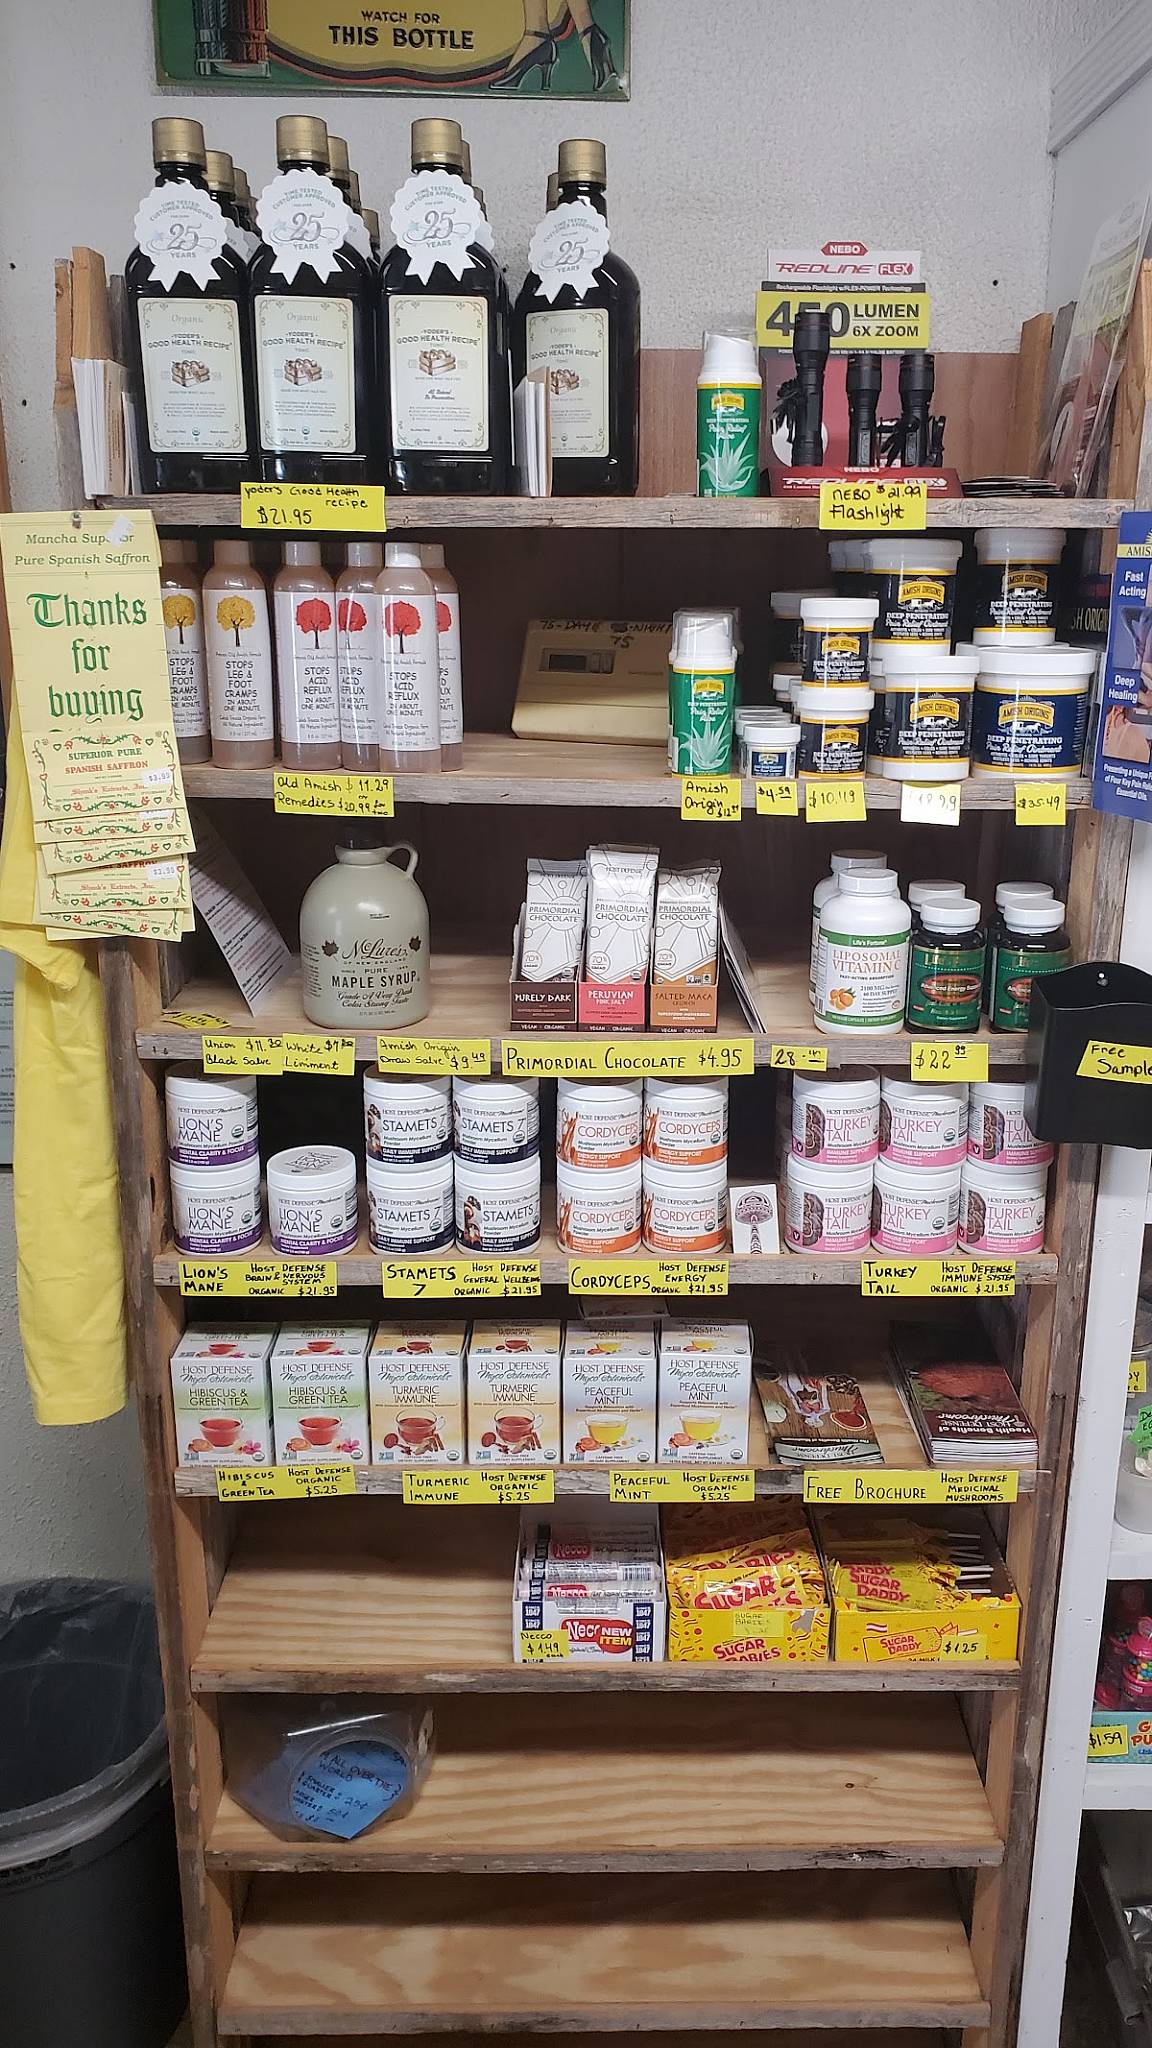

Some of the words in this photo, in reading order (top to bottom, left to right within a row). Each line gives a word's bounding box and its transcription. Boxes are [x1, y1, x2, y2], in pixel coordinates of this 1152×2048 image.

[361, 10, 406, 23] WATCH
[413, 13, 440, 24] FOR
[329, 25, 379, 47] THIS
[392, 28, 475, 50] BOTTLE
[293, 212, 325, 241] 25
[829, 245, 860, 253] NEBO
[776, 263, 876, 273] REDLINE
[880, 264, 910, 274] FLEX
[854, 305, 919, 317] LUMEN
[853, 326, 871, 336] 6X
[875, 326, 918, 336] ZOOM
[147, 341, 169, 349] GOOD
[290, 487, 322, 495] Good
[327, 488, 359, 496] Health
[832, 490, 870, 500] NEBO
[326, 499, 368, 508] recipe
[257, 506, 312, 524] $21.95
[830, 504, 904, 525] Flashlight
[26, 534, 76, 544] Mancha
[15, 556, 44, 565] Pure
[49, 554, 100, 566] Spanish
[105, 554, 150, 565] Saffron
[1125, 571, 1143, 582] Fast
[1119, 586, 1146, 599] Acting
[26, 592, 147, 627] Thanks
[72, 639, 110, 673] for
[228, 680, 252, 688] FOOT
[309, 676, 328, 684] ACID
[1115, 675, 1135, 687] Deep
[224, 690, 257, 698] CRAMPS
[304, 686, 332, 694] REFLUX
[1108, 688, 1138, 703] Healing
[49, 684, 144, 723] buying
[1003, 708, 1022, 718] AMISH
[1024, 706, 1050, 718] ORIGINS
[69, 751, 113, 760] SUPERIOR
[118, 748, 142, 756] PURE
[65, 765, 103, 774] SPANISH
[107, 761, 148, 770] SAFFRON
[278, 777, 298, 788] Old
[305, 778, 341, 791] Amish
[686, 781, 728, 793] Amish
[275, 792, 334, 808] Remedies
[685, 797, 723, 815] Origin
[832, 960, 891, 973] VITAMIN
[332, 976, 374, 988] MAPLE
[515, 994, 545, 1002] PURELY
[547, 993, 571, 1002] DARK
[588, 990, 634, 999] PERUVIAN
[205, 1039, 236, 1048] Union
[287, 1044, 323, 1054] White
[380, 1039, 417, 1050] Amish
[424, 1042, 460, 1059] Origin
[1092, 1045, 1126, 1058] Free
[206, 1054, 237, 1064] Black
[243, 1057, 271, 1065] Salve
[416, 1056, 444, 1065] Salve
[507, 1047, 596, 1070] PRIMORDIAL
[605, 1047, 686, 1070] CHOCOLATE
[698, 1047, 742, 1067] $4.95
[178, 1118, 223, 1131] LION'S
[893, 1119, 942, 1131] TURKEY
[178, 1129, 220, 1142] MANE
[893, 1130, 916, 1142] TAIL
[183, 1264, 228, 1279] LION'S
[251, 1263, 275, 1272] HOST
[282, 1264, 326, 1272] DEFENSE
[387, 1264, 456, 1280] STAMETS
[472, 1263, 493, 1272] HOST
[501, 1263, 537, 1272] DEFENSE
[659, 1262, 681, 1272] HOST
[687, 1263, 726, 1273] DEFENSE
[864, 1262, 917, 1278] TURKEY
[942, 1262, 966, 1273] HOST
[972, 1262, 1012, 1274] DEFENSE
[464, 1275, 499, 1283] GENERAL
[571, 1267, 650, 1289] CORDYCEPS
[665, 1274, 706, 1282] ENERGY
[942, 1274, 982, 1282] IMMUNE
[184, 1281, 223, 1292] MANE
[298, 1286, 334, 1296] $21.95
[413, 1284, 426, 1296] 7
[454, 1287, 491, 1296] ORGANIC
[500, 1285, 537, 1297] $21.95
[689, 1283, 723, 1294] $21.95
[866, 1281, 899, 1294] TAIL
[931, 1285, 968, 1293] ORGANIC
[976, 1283, 1009, 1293] $21.95
[211, 1366, 252, 1374] DEFENSE
[190, 1389, 236, 1397] HIBISCUS
[219, 1471, 274, 1481] HIBISCUS
[288, 1468, 309, 1476] HOST
[481, 1472, 505, 1482] HOST
[509, 1473, 546, 1481] DEFENSE
[683, 1473, 707, 1482] HOST
[710, 1473, 750, 1482] DEFENSE
[296, 1476, 341, 1484] ORGANIC
[405, 1474, 469, 1487] TURMERIC
[614, 1474, 670, 1486] PEACEFUL
[941, 1472, 964, 1484] HOST
[968, 1473, 1008, 1482] DEFENSE
[222, 1488, 254, 1497] GREEN
[258, 1487, 275, 1496] TEA
[306, 1486, 338, 1497] $5.25
[692, 1484, 737, 1492] ORGANIC
[807, 1477, 842, 1499] FREE
[854, 1478, 926, 1500] BROCHURE
[948, 1484, 1000, 1492] MEDICINAL
[410, 1490, 459, 1501] IMMUNE
[499, 1492, 530, 1503] $5.25
[614, 1488, 651, 1500] MINT
[700, 1492, 730, 1501] $5.25
[946, 1493, 1003, 1502] MUSHROOMS
[857, 1585, 910, 1602] DADDY
[526, 1606, 540, 1616] 1847
[602, 1628, 632, 1636] NEW
[600, 1637, 631, 1645] ITEM
[528, 1643, 558, 1654] $1.49
[714, 1639, 765, 1658] SUGAR
[945, 1641, 978, 1654] $1.25
[1089, 1732, 1122, 1749] $1.59
